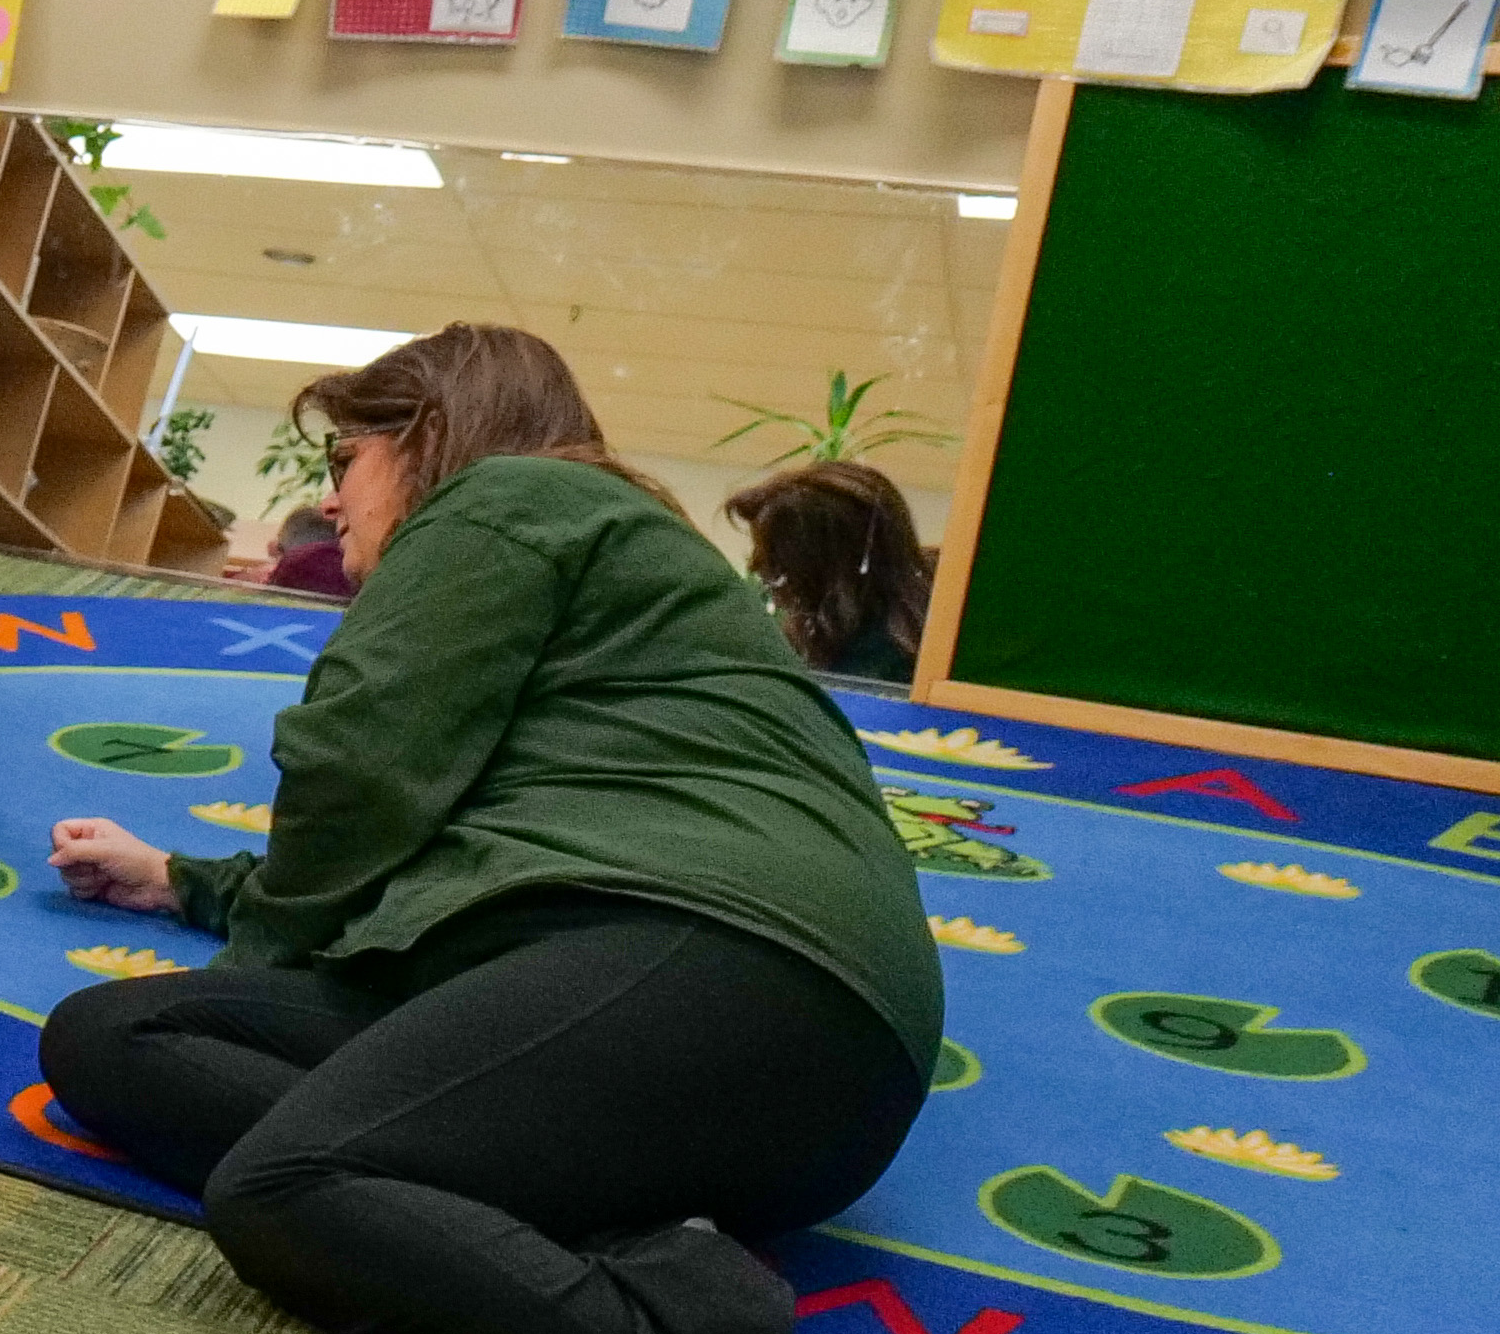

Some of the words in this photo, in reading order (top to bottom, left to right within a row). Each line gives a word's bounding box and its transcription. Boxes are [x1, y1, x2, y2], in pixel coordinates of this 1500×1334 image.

[211, 617, 320, 663] X
[98, 737, 175, 764] 7
[1109, 768, 1303, 822] A
[1139, 1010, 1239, 1051] 9
[1057, 1207, 1173, 1264] 3
